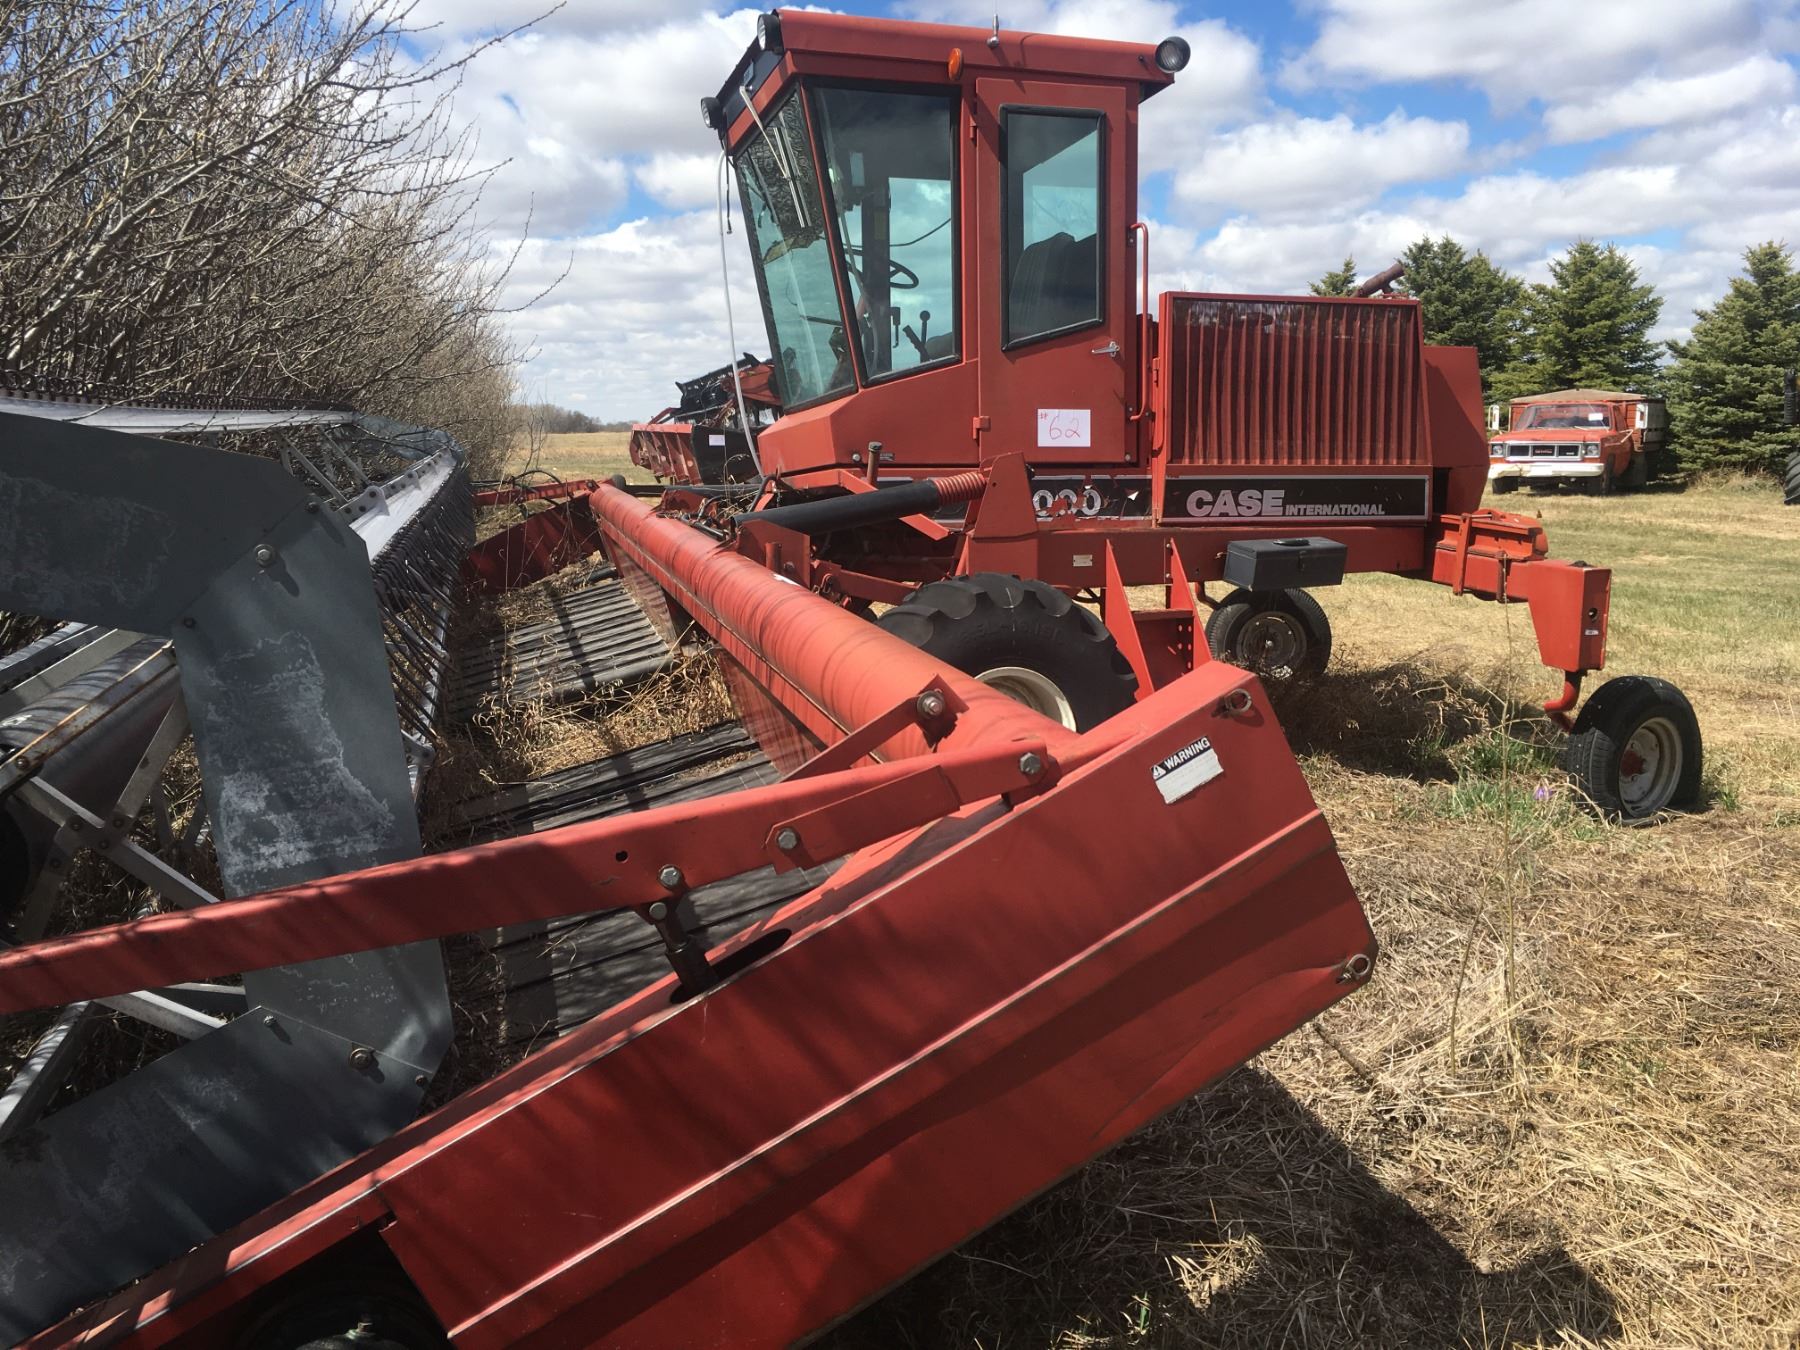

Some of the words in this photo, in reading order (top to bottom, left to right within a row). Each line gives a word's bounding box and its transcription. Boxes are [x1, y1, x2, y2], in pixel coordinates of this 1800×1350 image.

[1186, 489, 1285, 517] CASE
[1285, 503, 1385, 516] INTERNATIONAL
[1164, 737, 1211, 770] WARNING
